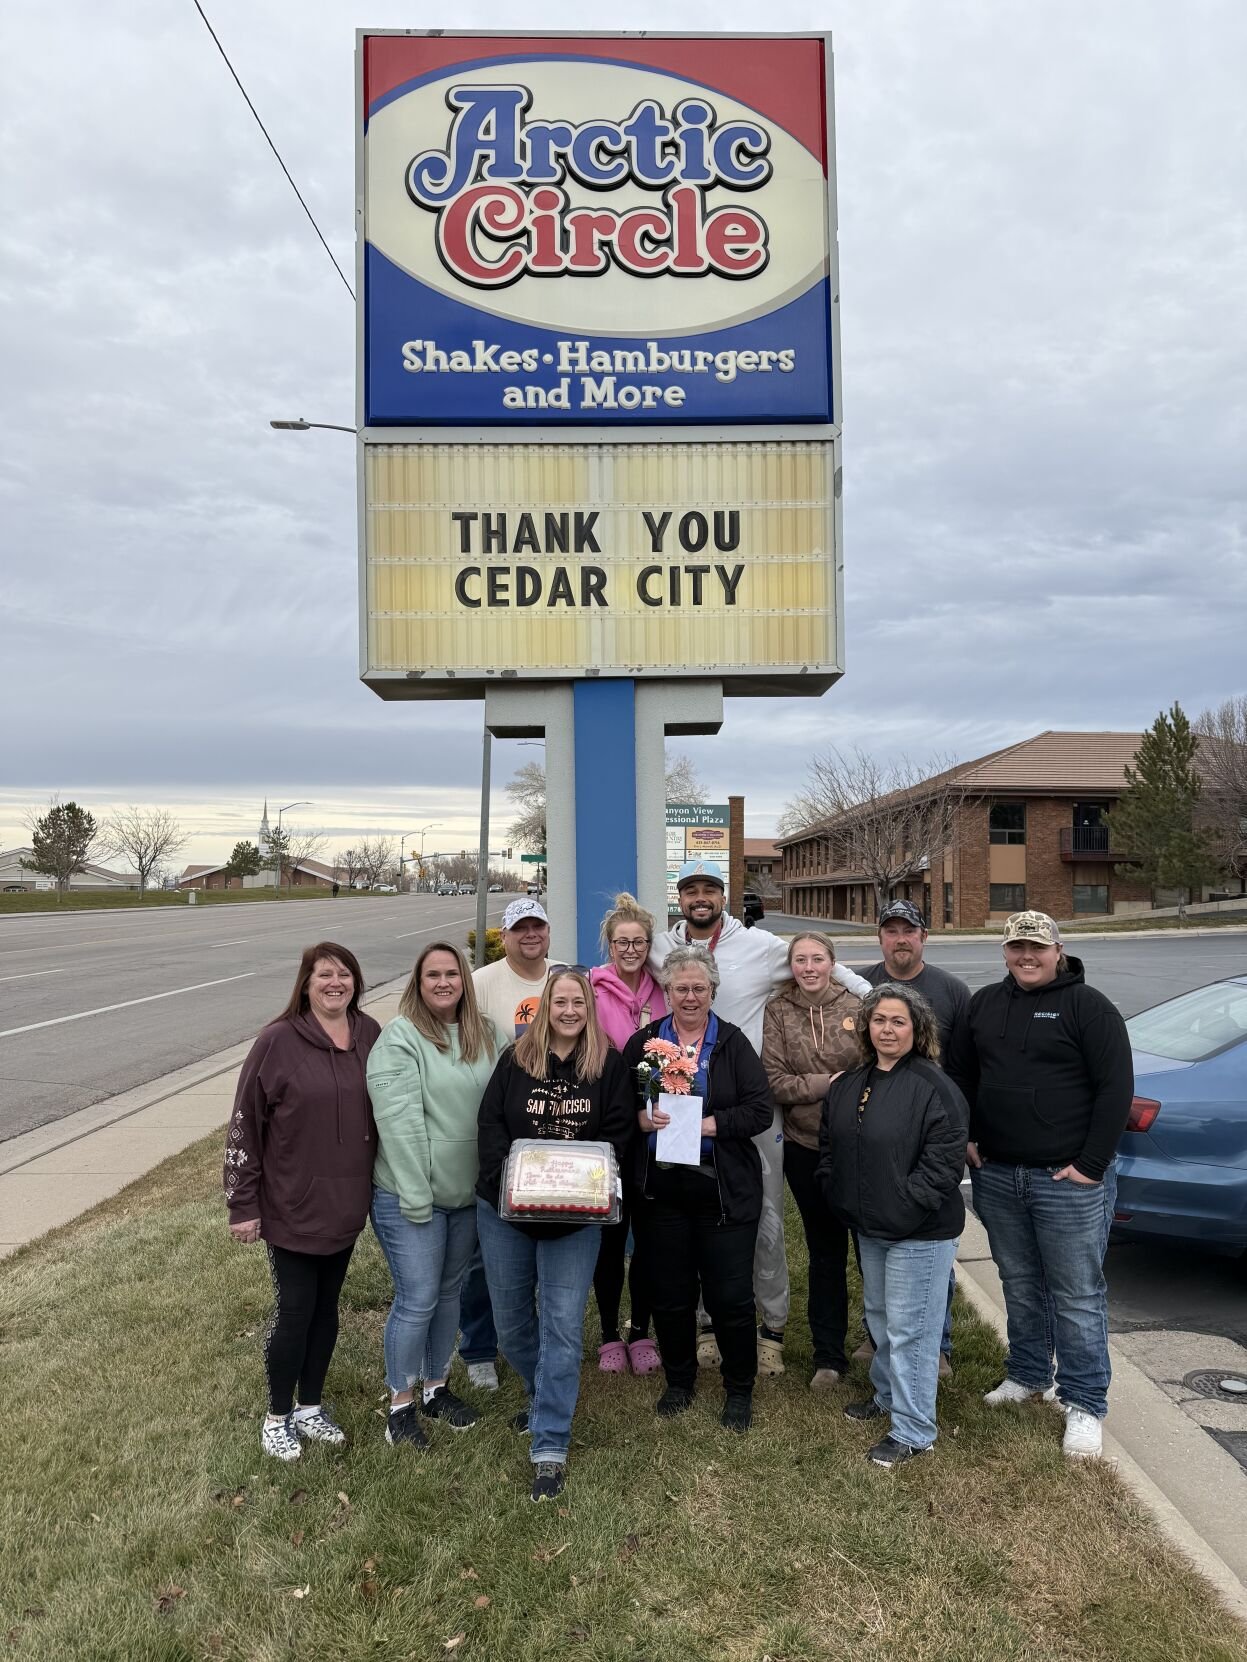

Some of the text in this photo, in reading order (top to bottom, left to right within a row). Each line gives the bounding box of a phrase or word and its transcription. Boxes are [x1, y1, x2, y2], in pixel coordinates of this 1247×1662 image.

[406, 84, 771, 211] Arctic
[436, 183, 769, 289] Circle
[402, 340, 795, 383] Shakes Hamburgers
[503, 377, 686, 409] and More
[452, 510, 740, 554] THANK YOU
[454, 564, 745, 608] CEDAR CITY
[665, 807, 714, 816] anyon View
[526, 1098, 591, 1116] SAN FRANCISCO
